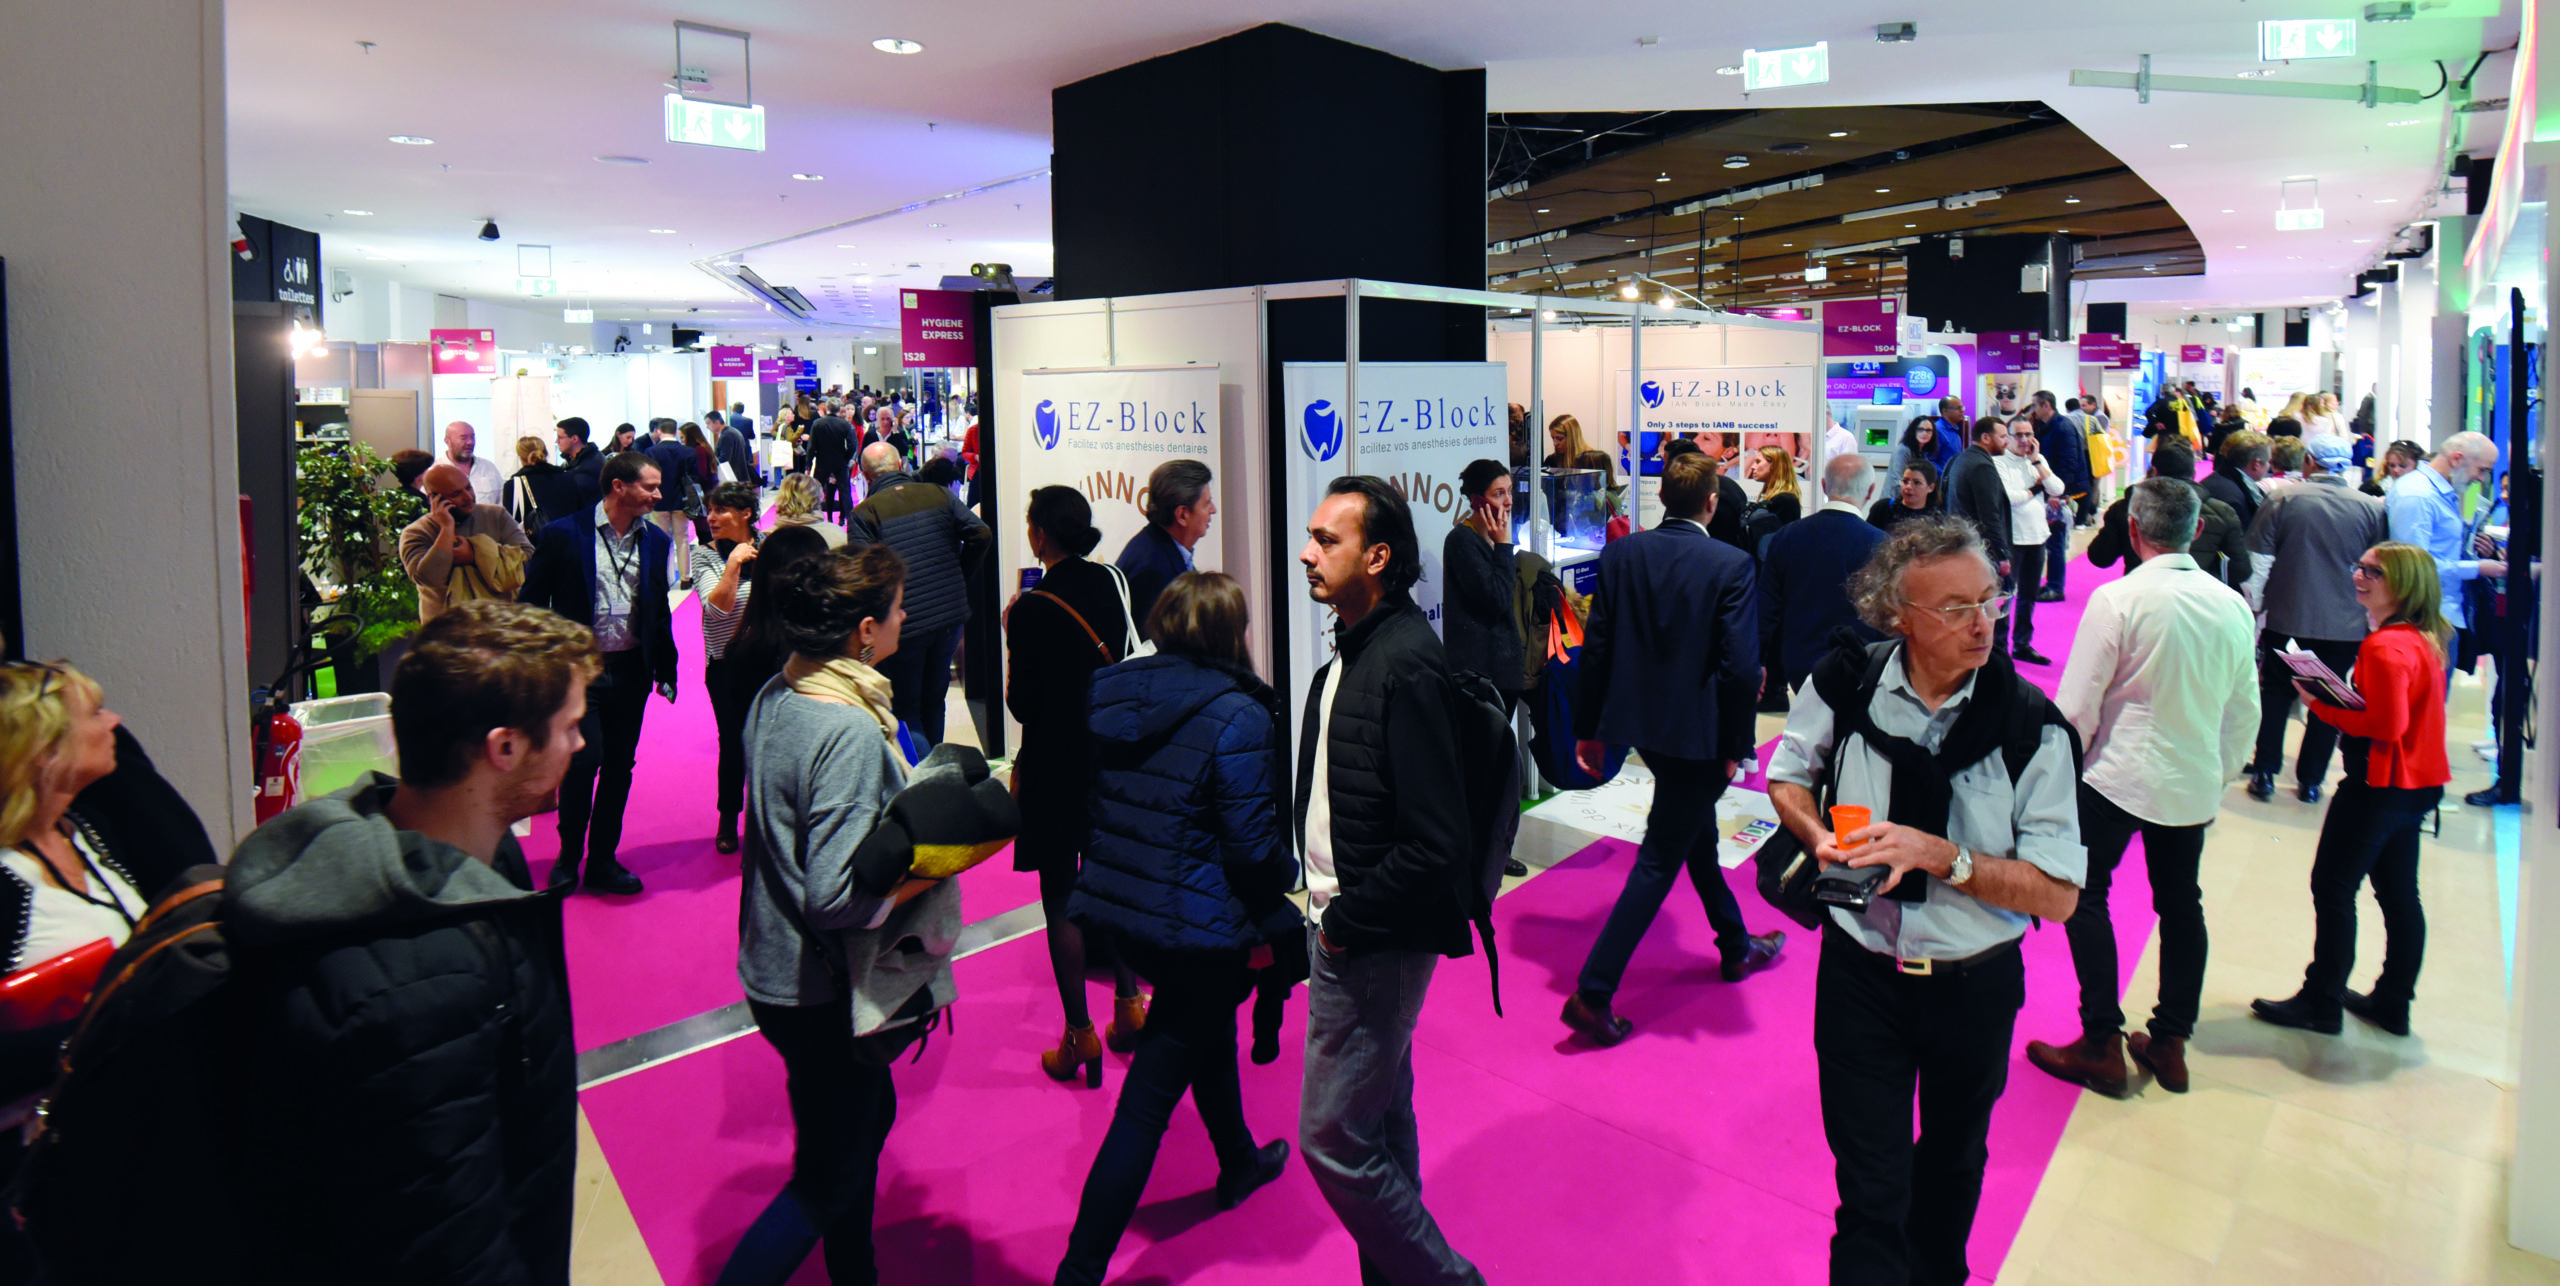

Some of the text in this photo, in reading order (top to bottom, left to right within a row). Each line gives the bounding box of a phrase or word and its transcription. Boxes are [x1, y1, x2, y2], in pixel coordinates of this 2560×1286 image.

[279, 288, 315, 305] toilettes
[921, 318, 964, 328] HYGIENE
[1838, 325, 1882, 333] EZ-BLOCK
[922, 331, 964, 340] EXPRESS
[1672, 380, 1786, 397] EZ-Block
[1068, 401, 1207, 434] EZ-Block
[1647, 421, 1666, 429] Only
[1068, 438, 1208, 454] Facilitez vos anesthésies dentaires
[1360, 443, 1391, 455] acilitez
[1394, 442, 1409, 451] vos
[1463, 434, 1497, 446] dentaires
